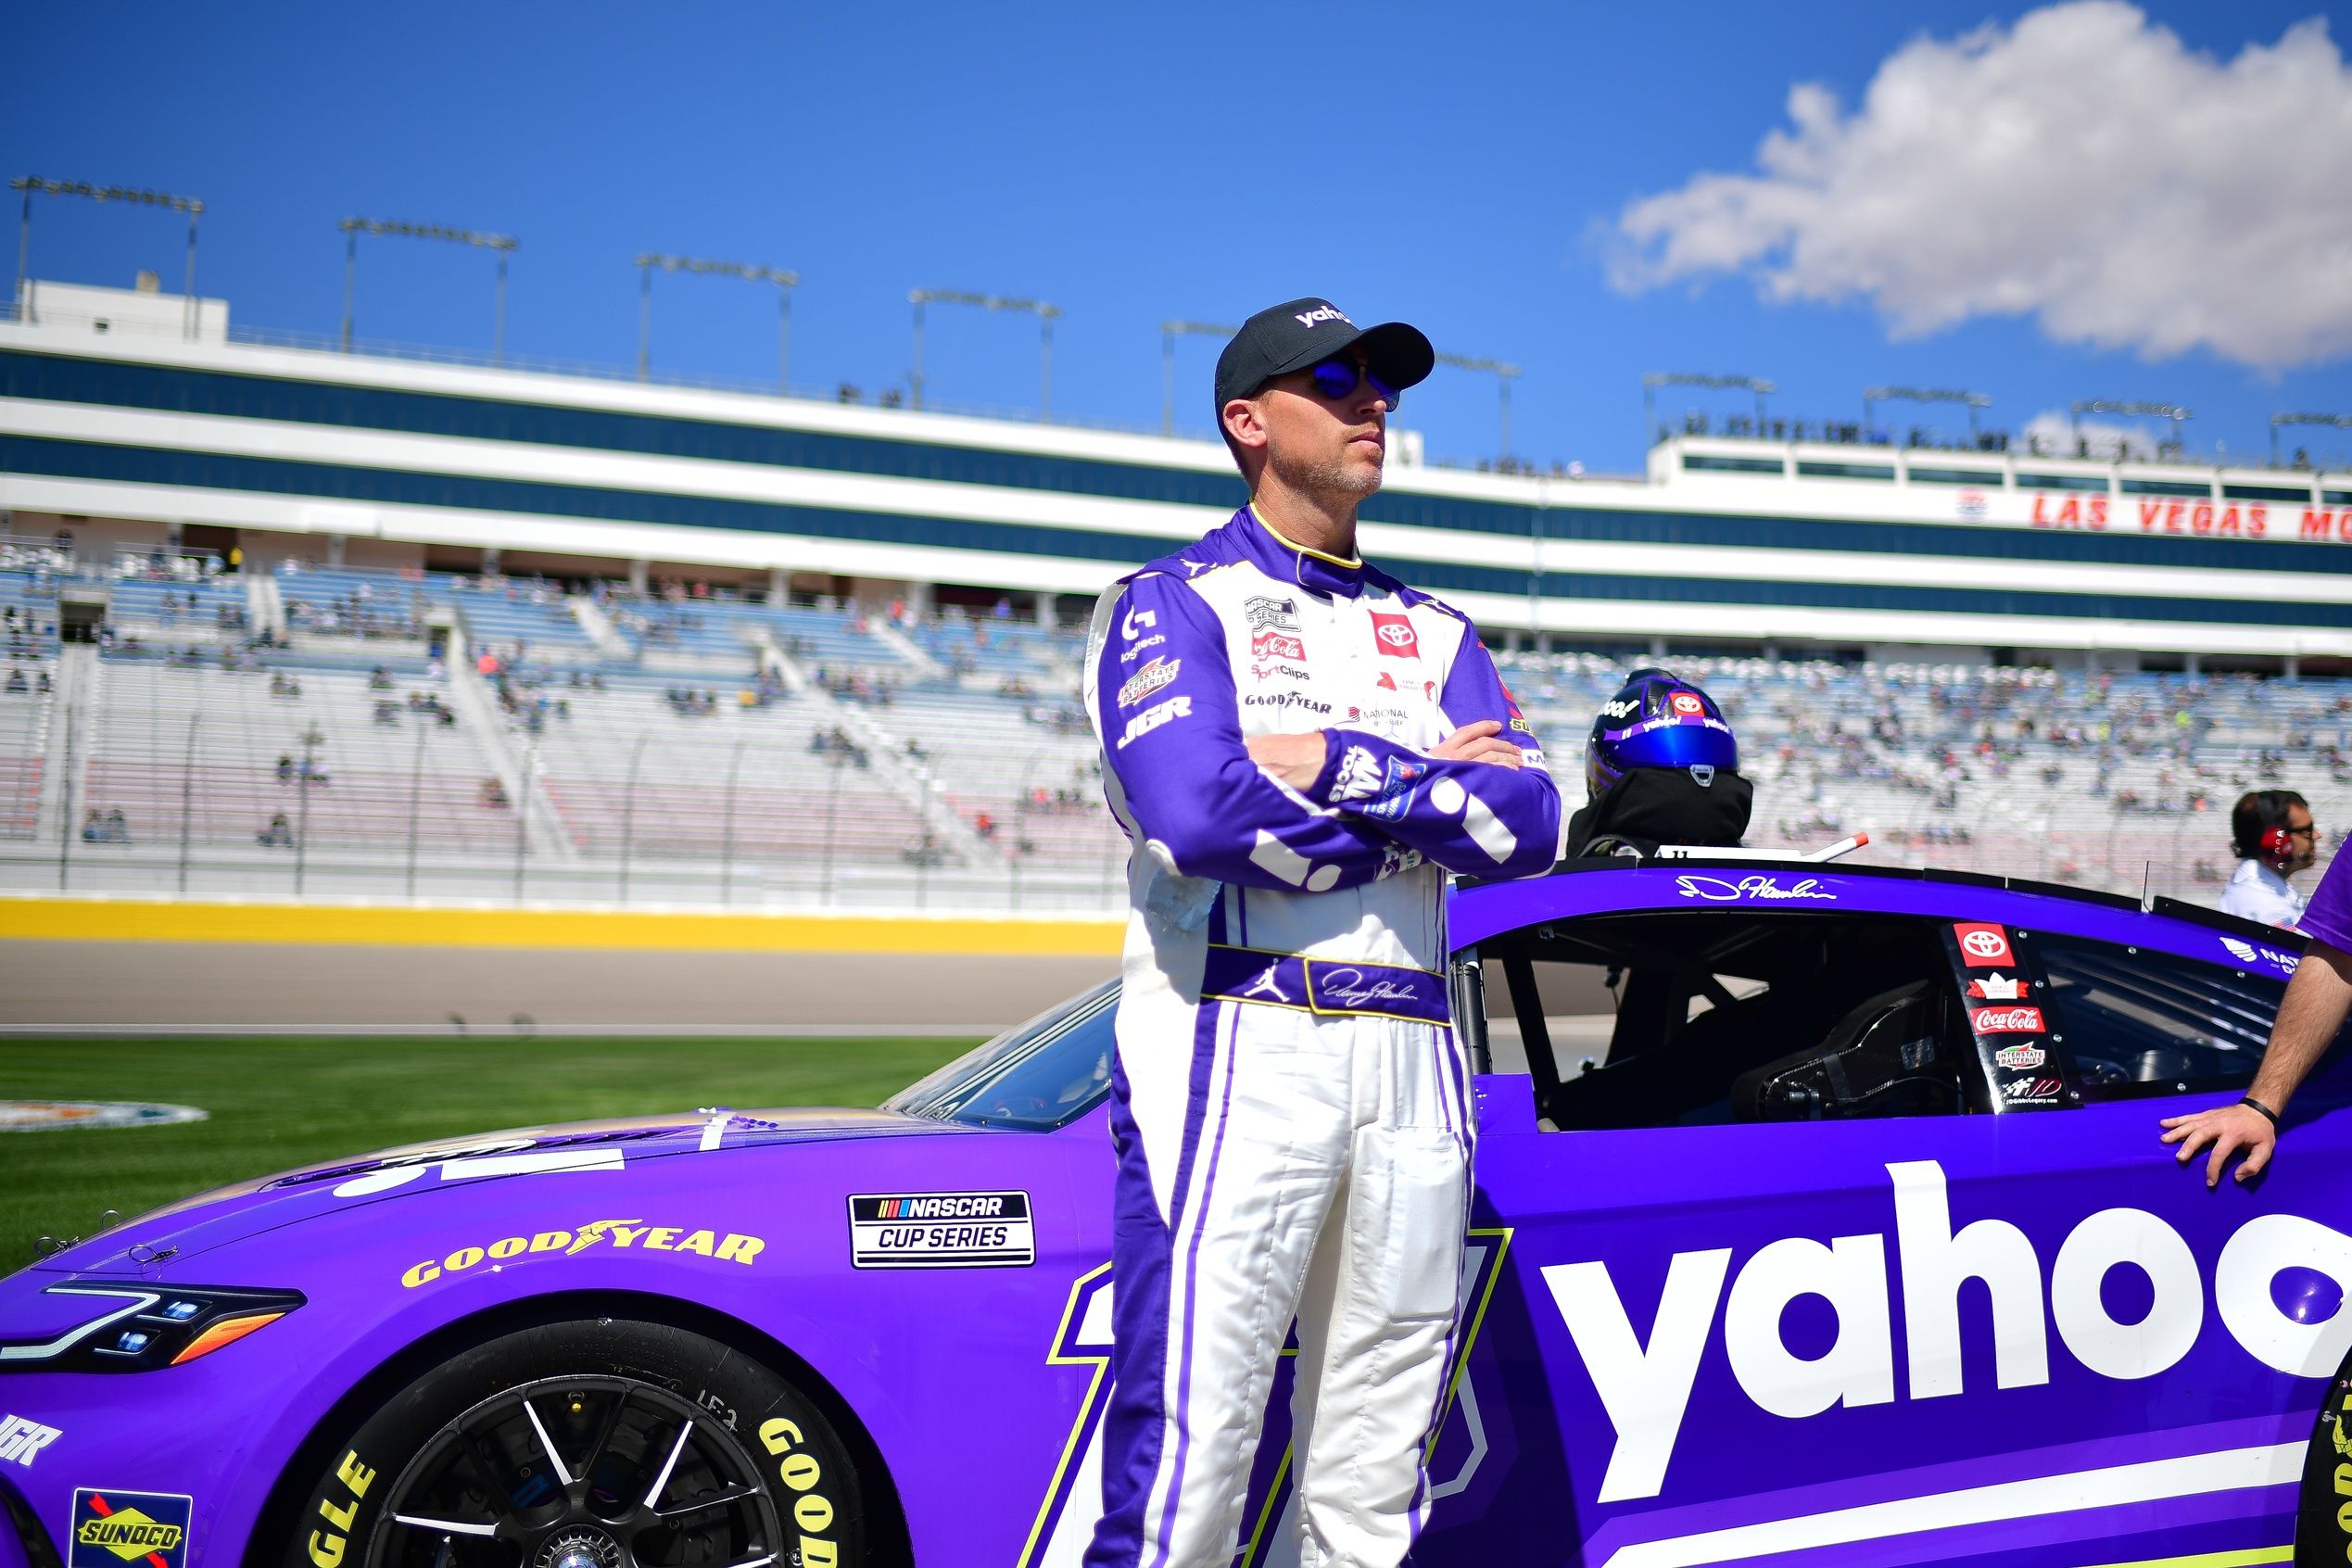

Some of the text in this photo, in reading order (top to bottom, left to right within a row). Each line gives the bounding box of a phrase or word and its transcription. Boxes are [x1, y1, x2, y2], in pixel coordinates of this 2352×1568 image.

[2030, 491, 2109, 531] LAS
[2139, 497, 2268, 538] VEGAS
[1120, 635, 1166, 664] logitech
[1120, 663, 1177, 697] INTERSTATE
[1122, 674, 1174, 704] BATTERIES
[1117, 697, 1193, 750] JGR
[1328, 745, 1359, 803] TOOLS
[1975, 1008, 2039, 1031] Coca-Cola
[2001, 1056, 2042, 1065] BATTERIES
[907, 1197, 1003, 1218] NASCAR
[879, 1226, 1008, 1248] CUP SERIES
[1539, 1160, 2352, 1504] yahoo
[82, 1523, 179, 1548] SUNOCO
